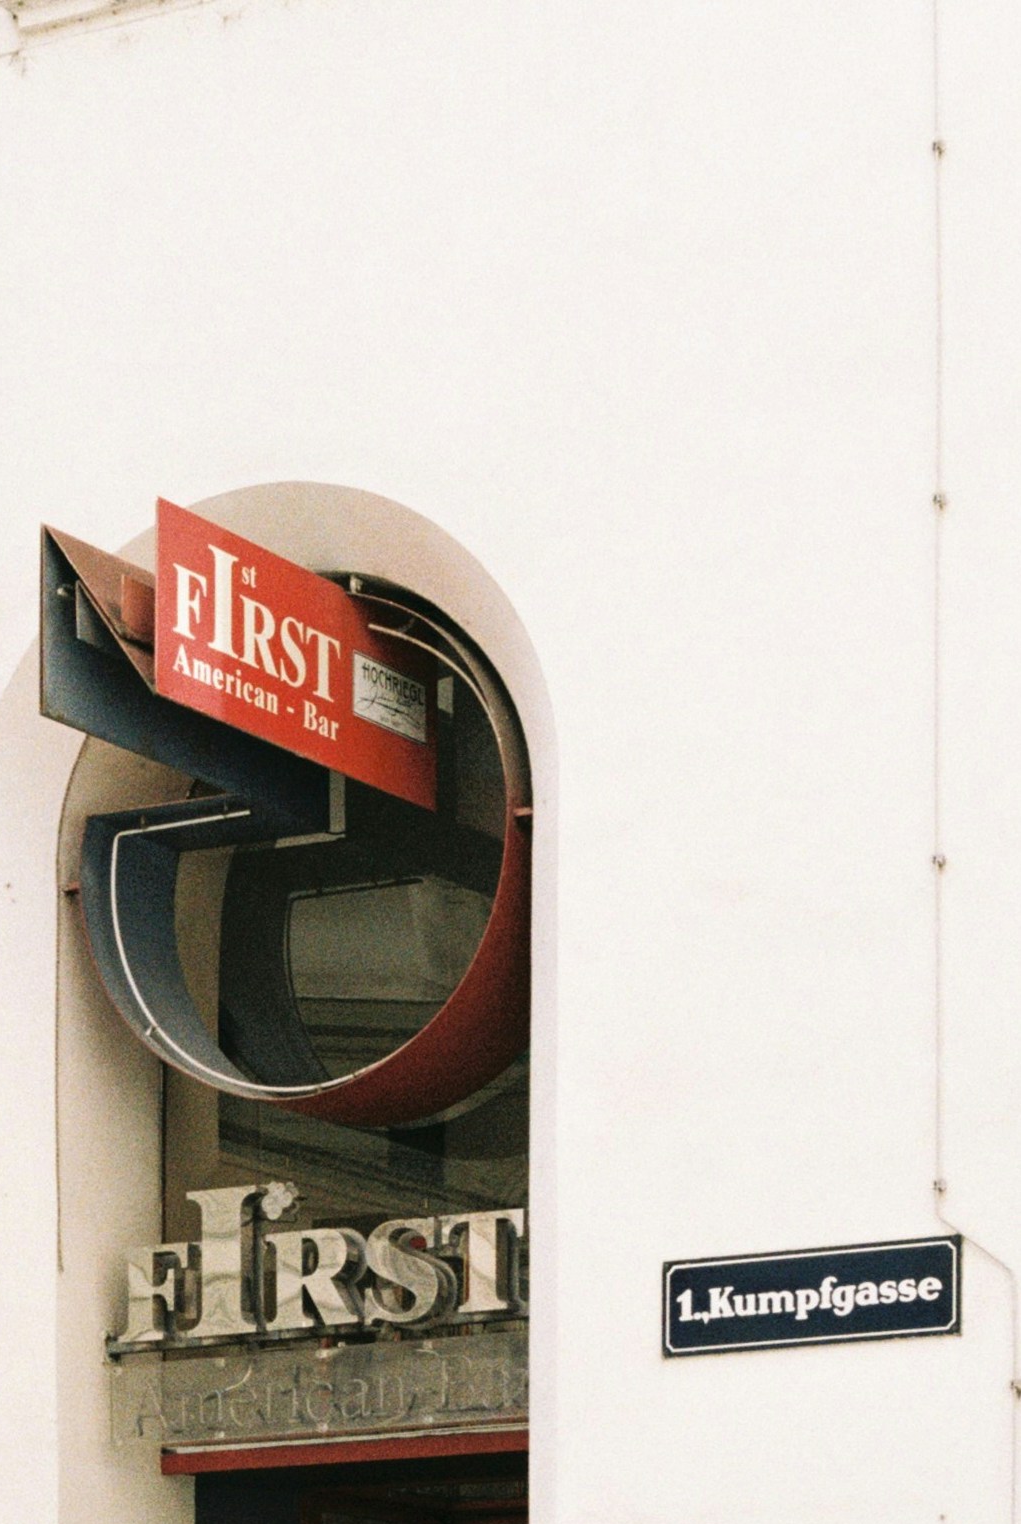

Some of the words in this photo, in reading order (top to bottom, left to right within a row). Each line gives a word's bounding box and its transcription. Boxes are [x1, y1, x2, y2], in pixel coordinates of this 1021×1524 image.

[172, 543, 341, 703] FIRST
[362, 662, 424, 706] HOCHRIEGL
[173, 644, 279, 717] American
[303, 701, 340, 742] Bar
[117, 1184, 525, 1344] FIRST
